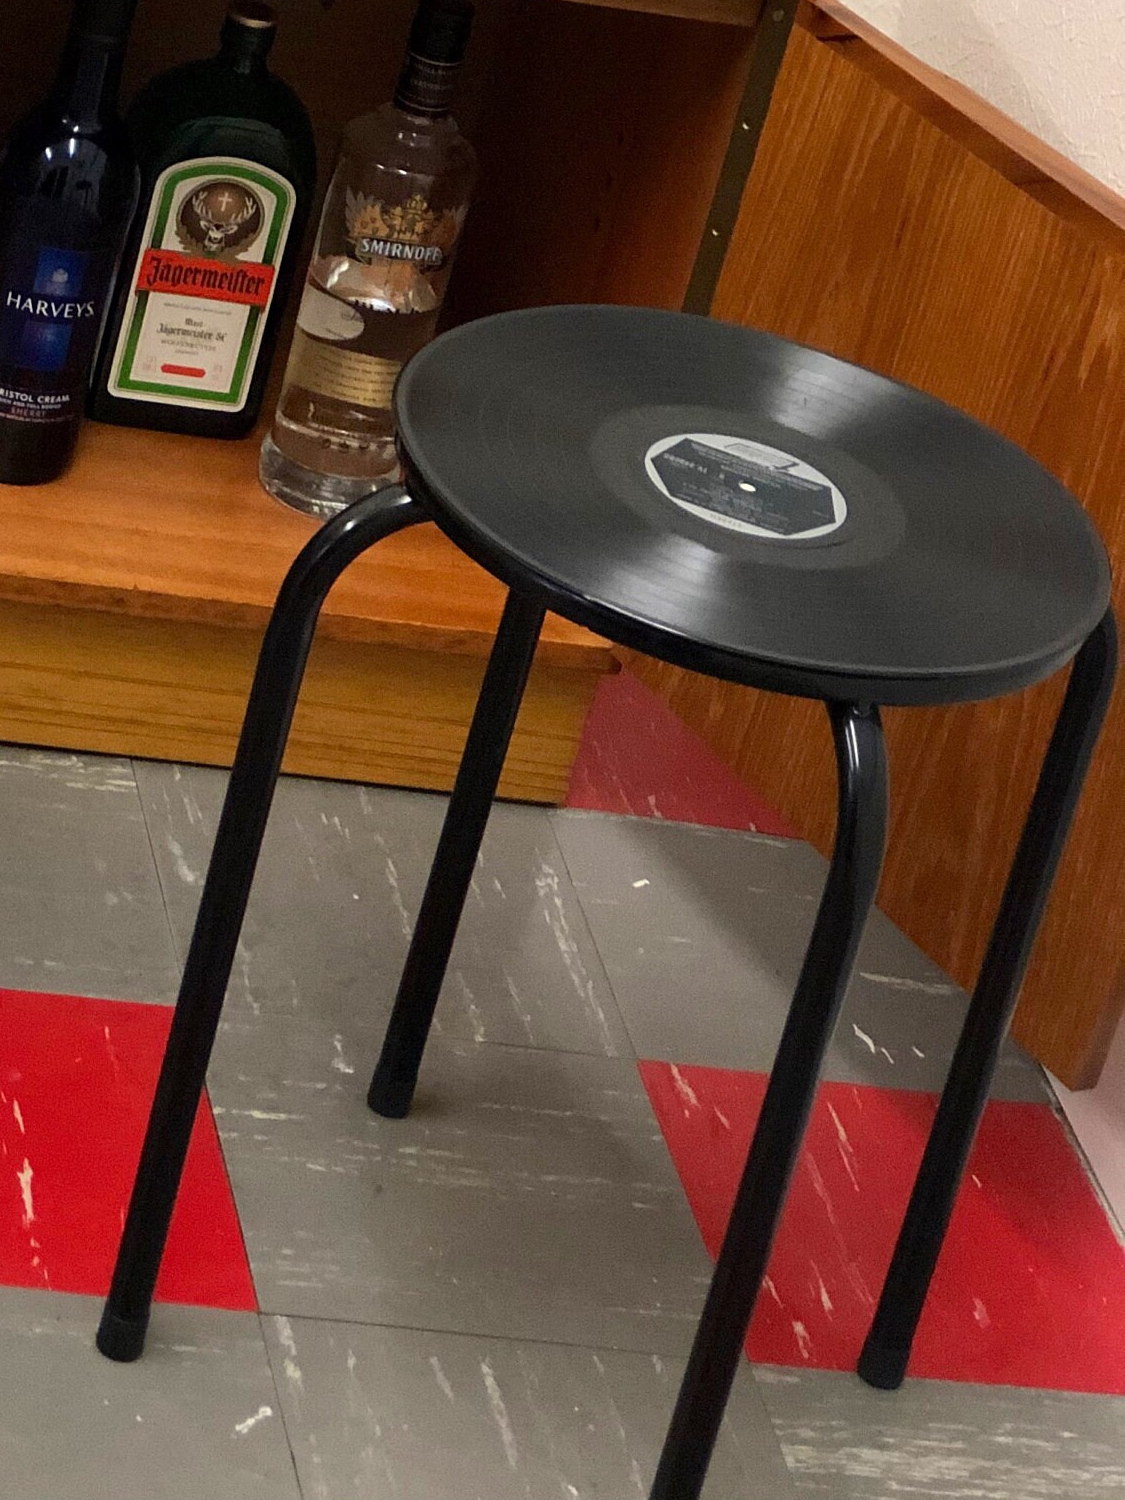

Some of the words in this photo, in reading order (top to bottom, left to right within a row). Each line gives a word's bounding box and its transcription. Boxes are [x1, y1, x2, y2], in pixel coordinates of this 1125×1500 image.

[361, 237, 441, 263] SMIRNOFF
[6, 291, 95, 319] HARVEYS
[37, 394, 71, 404] CREAM
